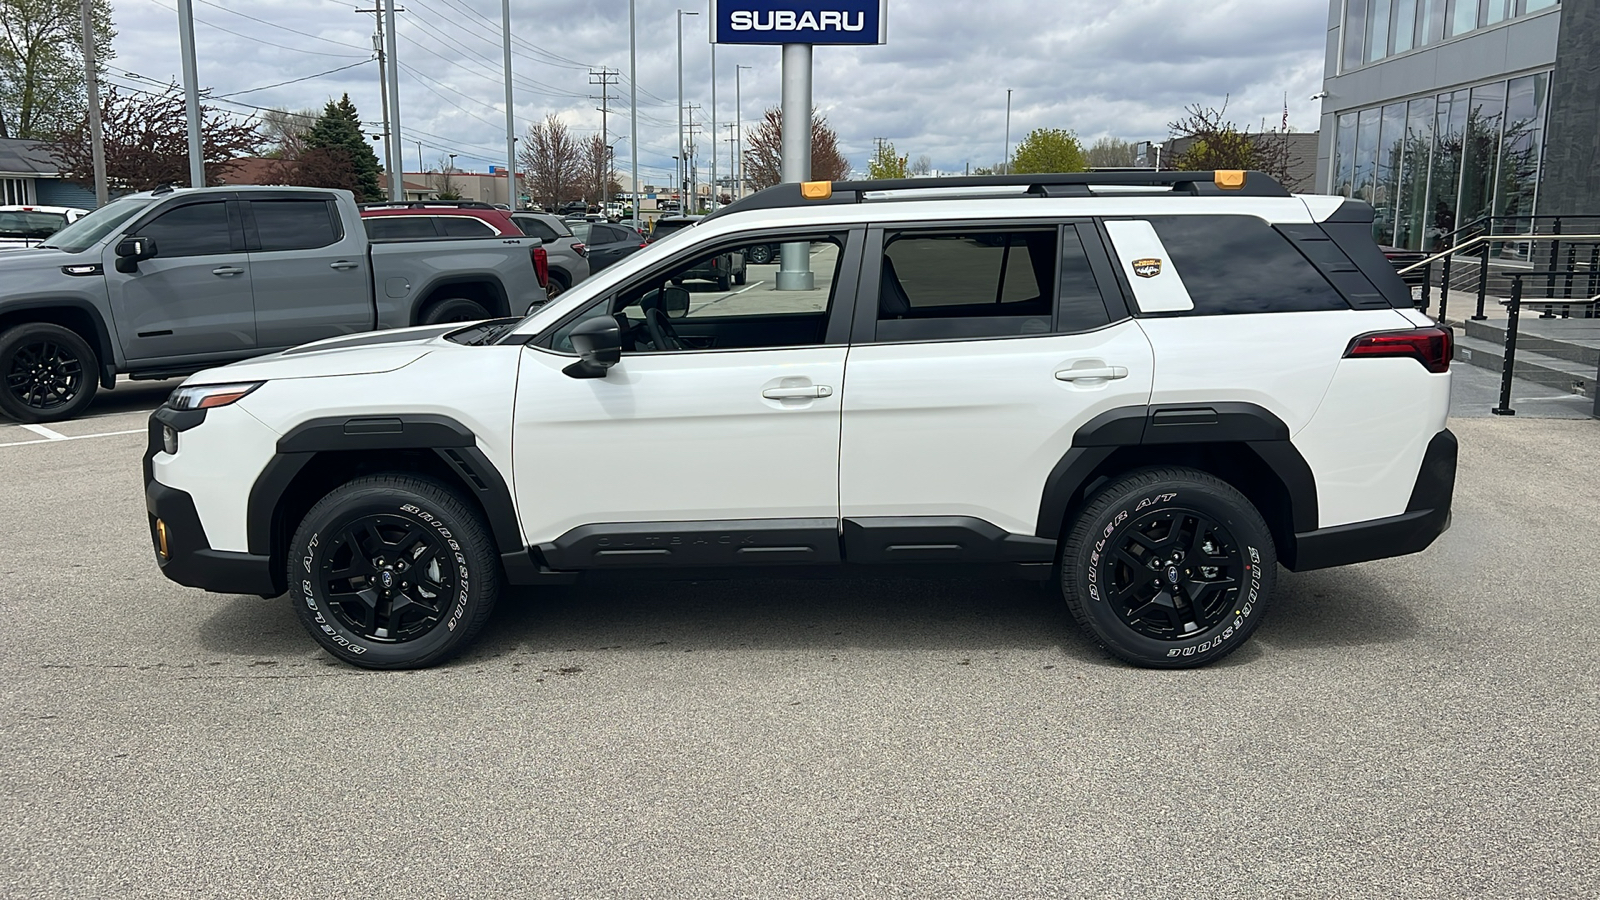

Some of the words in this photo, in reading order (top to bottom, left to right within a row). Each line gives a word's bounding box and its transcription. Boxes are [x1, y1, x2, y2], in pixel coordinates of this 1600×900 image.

[731, 11, 864, 31] SUBARU
[303, 533, 319, 573] A/T
[400, 503, 468, 631] BRIDGESTONE
[1088, 510, 1128, 600] DUELER
[1135, 493, 1177, 511] A/T
[303, 580, 367, 655] DUELER
[1167, 546, 1261, 657] BRIDGESTONE
